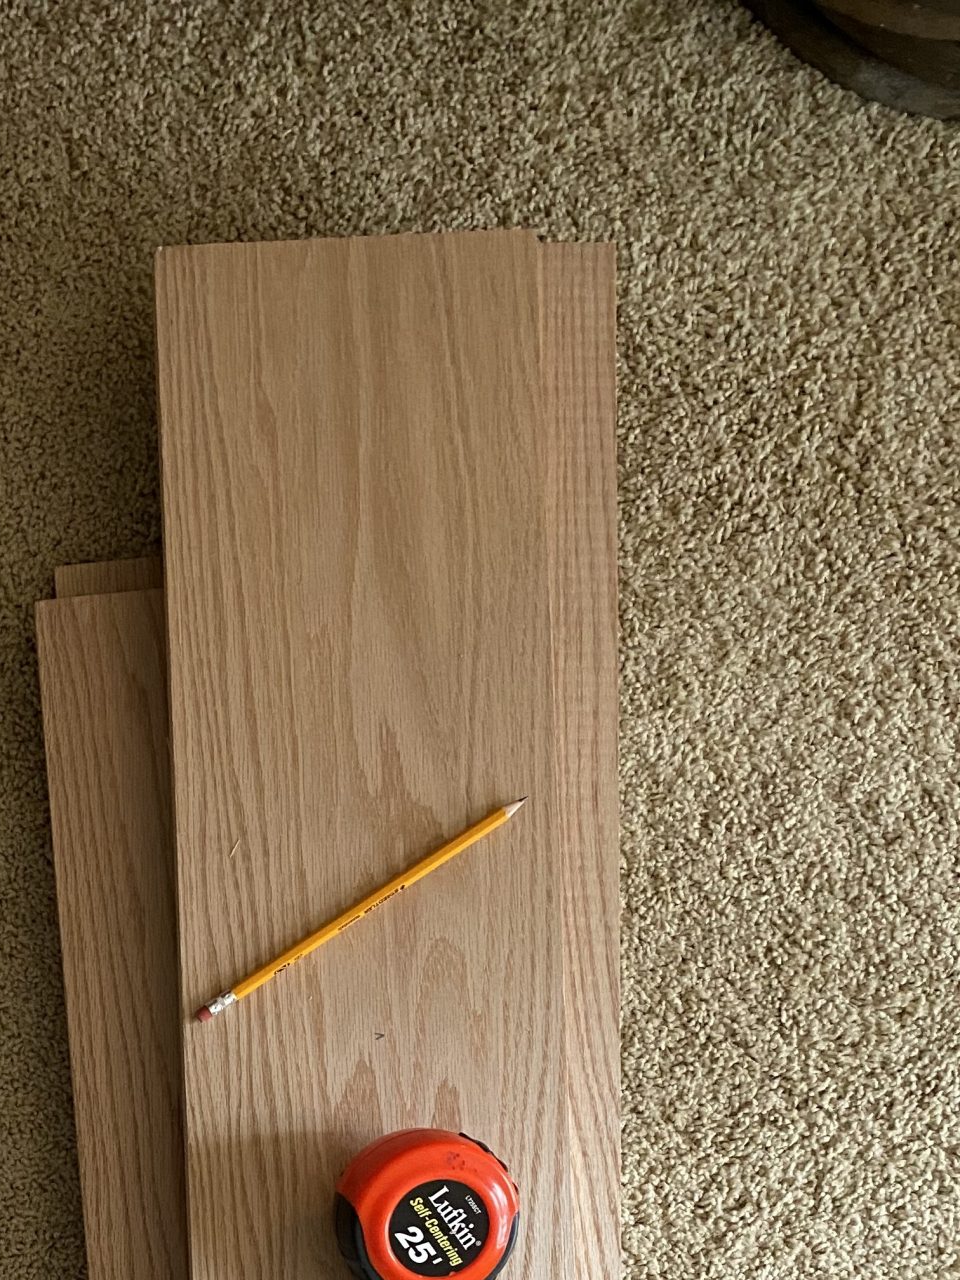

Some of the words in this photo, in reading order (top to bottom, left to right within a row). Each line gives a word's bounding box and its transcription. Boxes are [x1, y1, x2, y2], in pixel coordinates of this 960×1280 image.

[394, 1225, 443, 1265] 25'
[409, 1196, 464, 1267] Self-Centering
[428, 1184, 477, 1251] Lufkin
